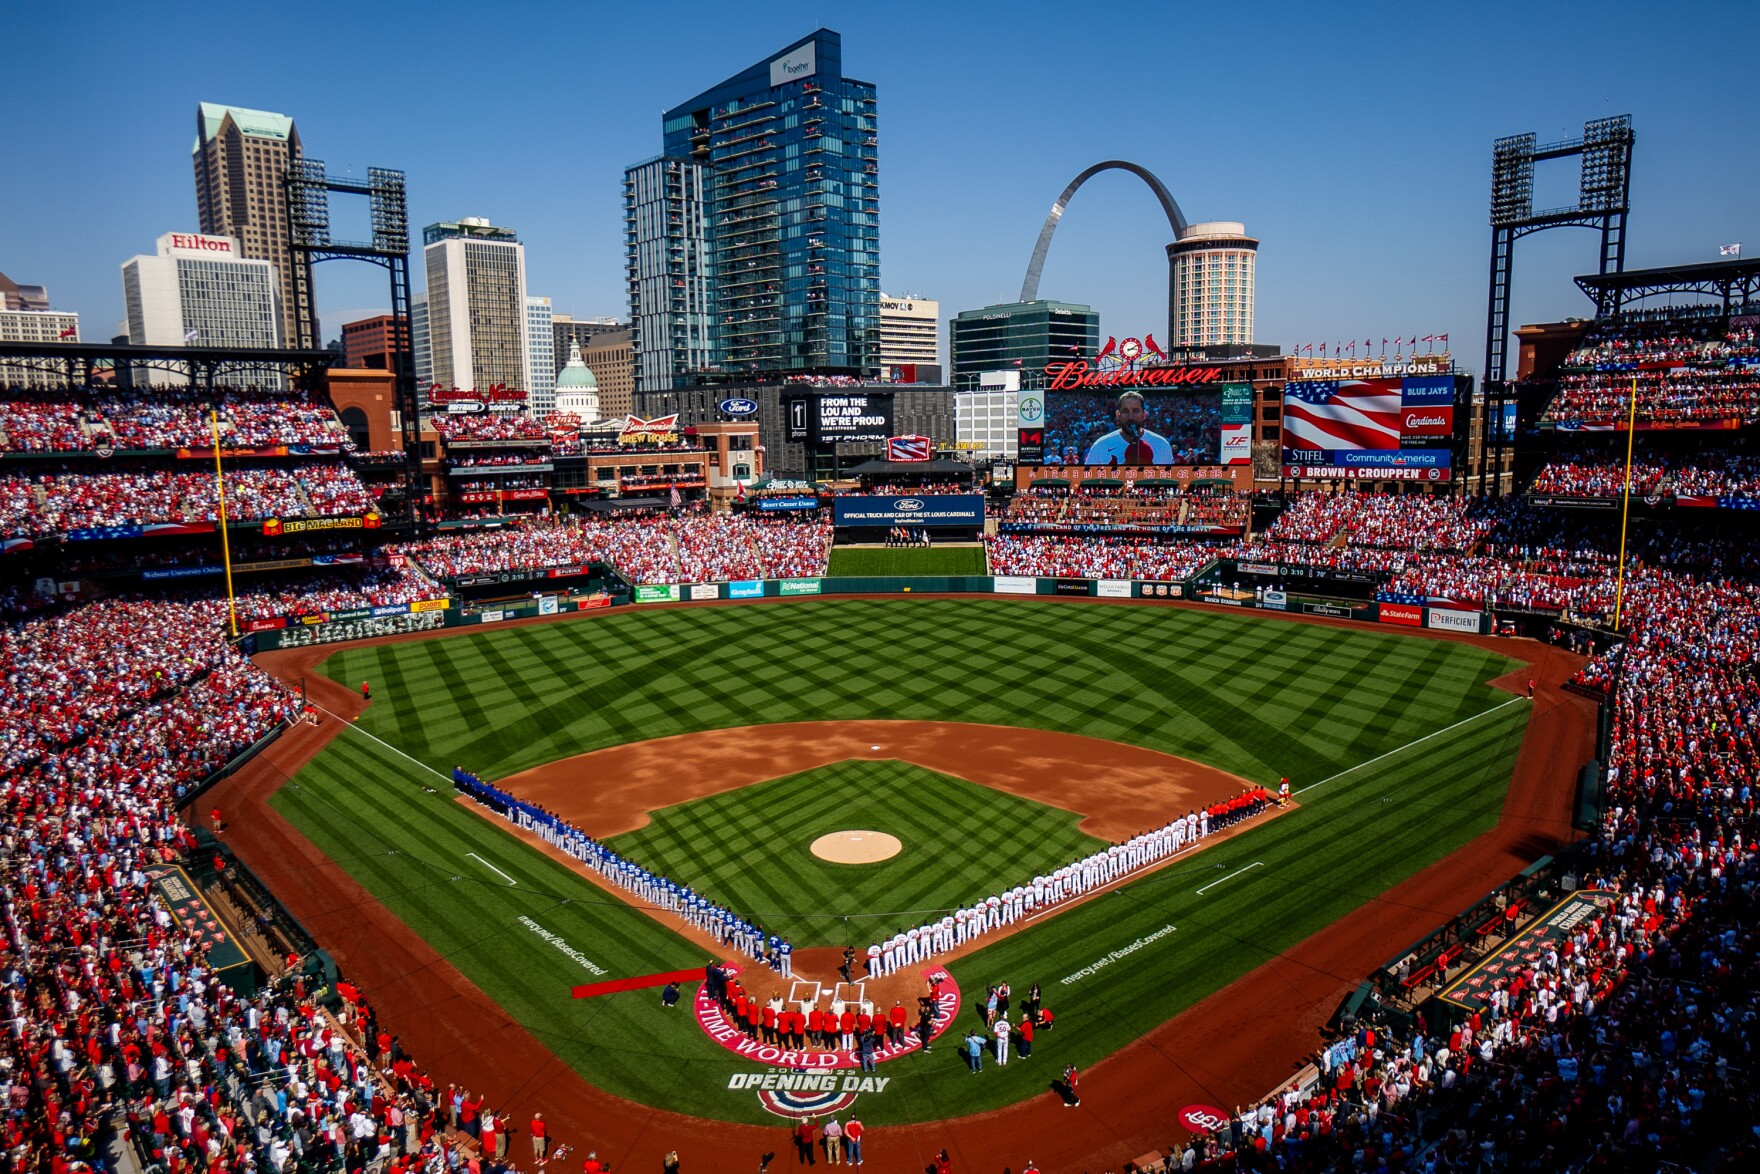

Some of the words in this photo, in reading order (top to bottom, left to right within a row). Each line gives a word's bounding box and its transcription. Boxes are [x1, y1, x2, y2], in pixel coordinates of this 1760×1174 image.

[787, 62, 809, 74] Together
[172, 234, 231, 252] Hilton
[880, 302, 899, 310] KMOV
[982, 312, 1012, 321] POLSINELLI
[1044, 360, 1222, 390] Budweiser
[1302, 368, 1349, 378] WORLD
[1352, 363, 1437, 376] CHAMPIONS
[428, 383, 482, 404] Cardinals
[484, 382, 528, 404] Nation
[1407, 387, 1426, 395] BLUE
[1428, 386, 1448, 395] JAYS
[728, 400, 750, 412] Ford
[821, 398, 848, 406] FROM
[850, 398, 867, 406] THE
[821, 407, 841, 416] LOU
[841, 407, 861, 416] AND
[821, 417, 851, 426] WE'RE
[852, 416, 885, 425] PROUD
[1405, 413, 1446, 428] Cardinals
[1506, 416, 1516, 424] LOV
[621, 420, 677, 433] Budweiser
[619, 434, 645, 443] BREW
[647, 433, 678, 442] HOUSE
[956, 442, 985, 450] SMOKE
[1292, 449, 1324, 460] STIFEL
[1044, 470, 1048, 478] 1
[1052, 470, 1058, 478] 2
[1062, 470, 1068, 478] 6
[1073, 470, 1078, 478] 9
[1084, 470, 1092, 478] 10
[1097, 470, 1107, 478] 14
[1111, 470, 1121, 478] 17
[1125, 470, 1137, 478] 20
[1143, 470, 1155, 478] 23
[1160, 470, 1172, 478] 24
[1176, 470, 1189, 478] 42
[1306, 467, 1346, 477] BROWN
[1358, 468, 1420, 478] CROUPPEN
[899, 500, 919, 509] Ford
[284, 521, 306, 533] BIG
[306, 519, 333, 530] MAC
[334, 518, 363, 528] LAND
[171, 569, 201, 577] University
[381, 605, 407, 615] Ballpark
[517, 915, 609, 975] mercy.net/BasesCovered
[1060, 924, 1177, 985] mercy.net/BasesCovered
[736, 1038, 838, 1067] WORLD
[849, 992, 957, 1063] CHAMIONS
[727, 1073, 838, 1091] OPENING
[842, 1077, 890, 1092] DAY
